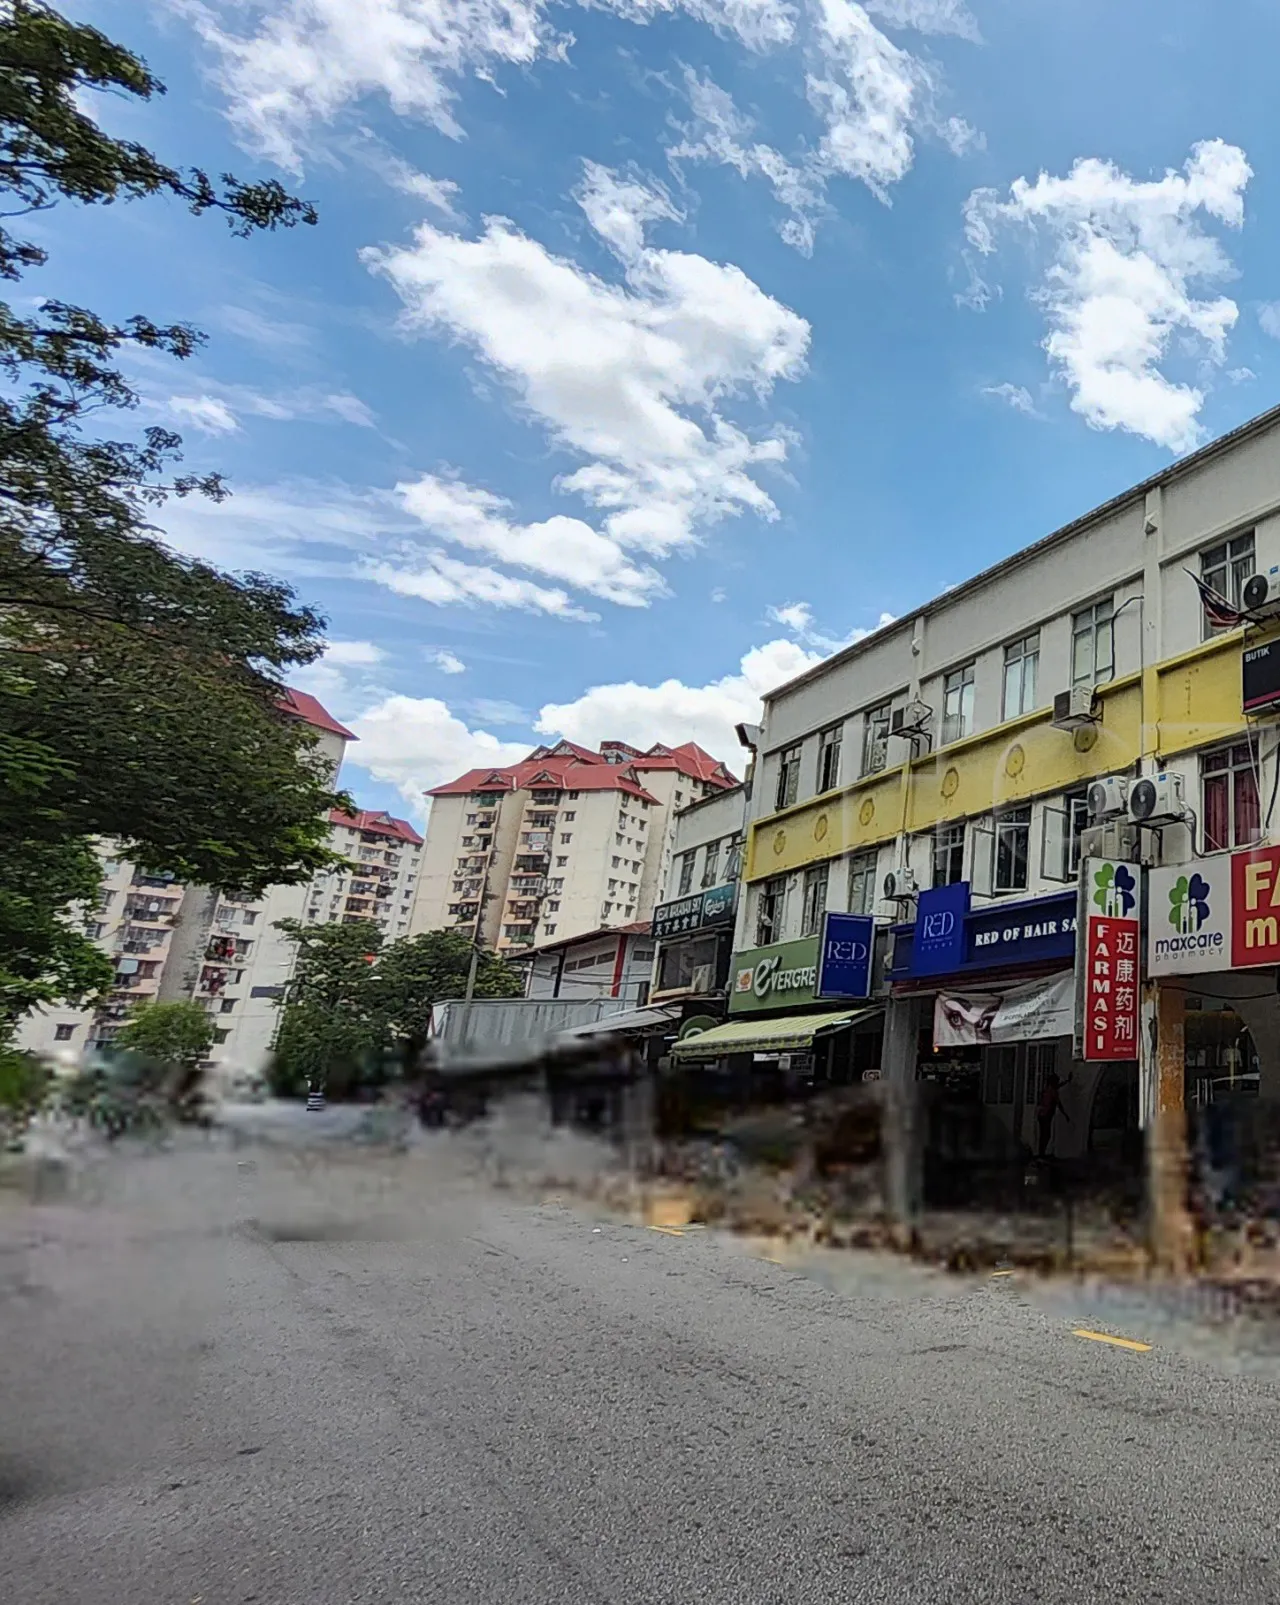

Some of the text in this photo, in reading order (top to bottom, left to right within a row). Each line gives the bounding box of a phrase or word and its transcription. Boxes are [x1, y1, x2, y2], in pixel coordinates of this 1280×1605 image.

[1245, 647, 1270, 662] BUTIK
[922, 911, 955, 940] RED
[975, 931, 999, 947] RED
[1002, 927, 1020, 942] OF
[1023, 921, 1057, 939] HAIR
[827, 941, 867, 960] RED
[1154, 948, 1225, 963] pharmacy
[1155, 931, 1224, 955] maxcare
[1092, 924, 1111, 1051] FARMASI
[1114, 931, 1135, 1041] 迈康药剂
